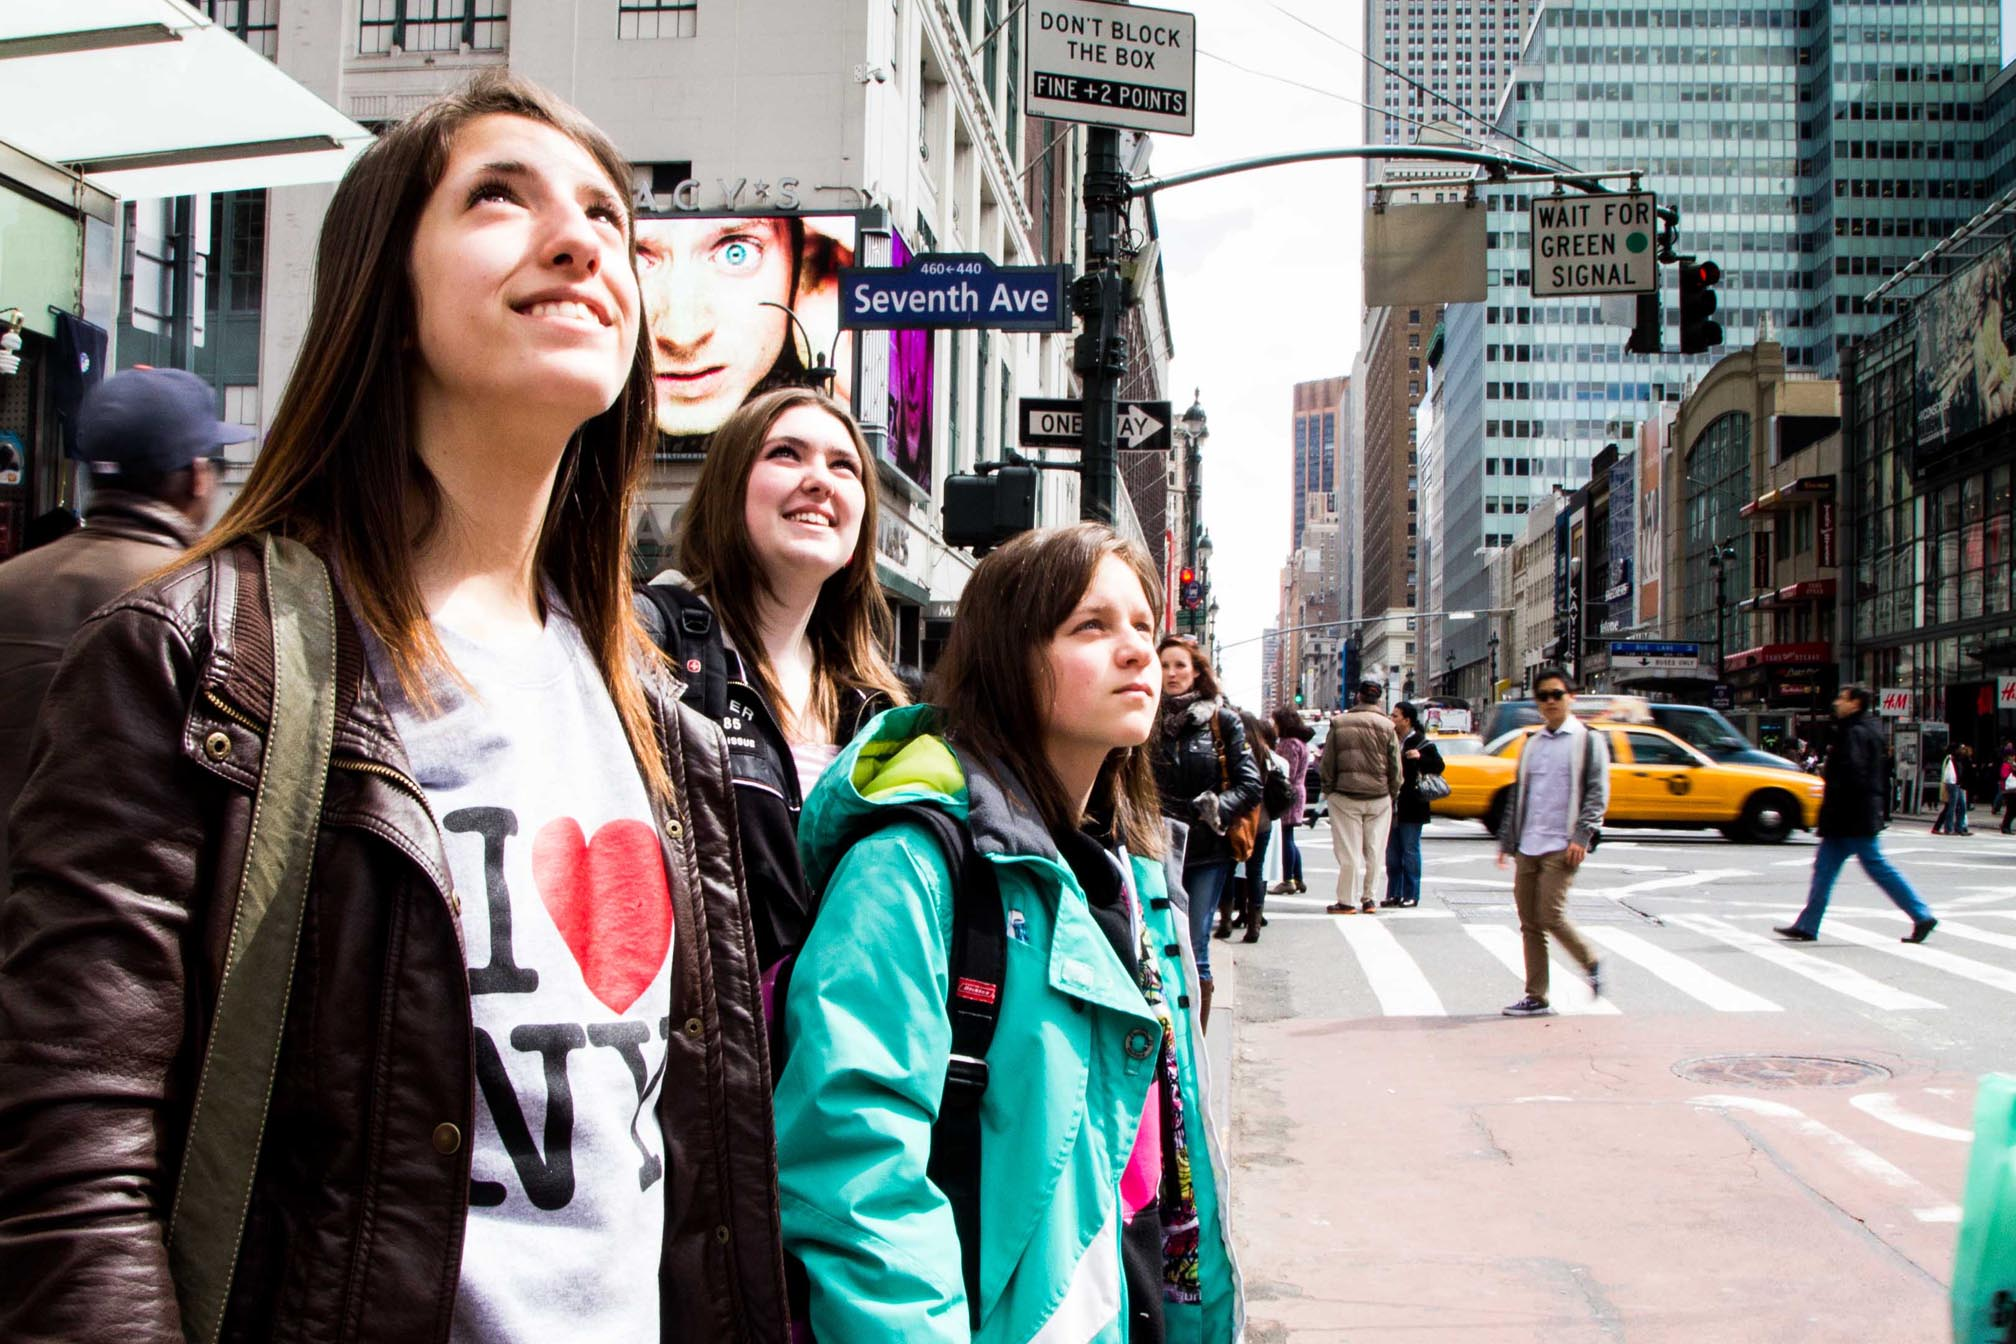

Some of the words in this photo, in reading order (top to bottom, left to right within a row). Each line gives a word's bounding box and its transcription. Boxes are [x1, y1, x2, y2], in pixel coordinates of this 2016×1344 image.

[1040, 11, 1103, 37] DON'T
[1111, 21, 1181, 48] BLOCK
[1067, 40, 1107, 64] THE
[1116, 47, 1155, 70] BOX
[1037, 75, 1078, 99] FINE
[1083, 83, 1113, 103] +2
[1119, 86, 1184, 112] POINTS
[1538, 204, 1591, 229] WAIT
[1604, 202, 1650, 226] FOR
[1541, 232, 1616, 258] GREEN
[920, 262, 944, 275] 460
[956, 262, 982, 275] 440
[1552, 263, 1636, 288] SIGNAL
[854, 281, 979, 314] Seventh
[988, 283, 1049, 313] Ave
[1041, 414, 1083, 434] ONE
[1117, 416, 1148, 436] AY
[1882, 693, 1908, 711] H&M
[442, 806, 539, 996] I
[468, 1017, 669, 1212] NY
